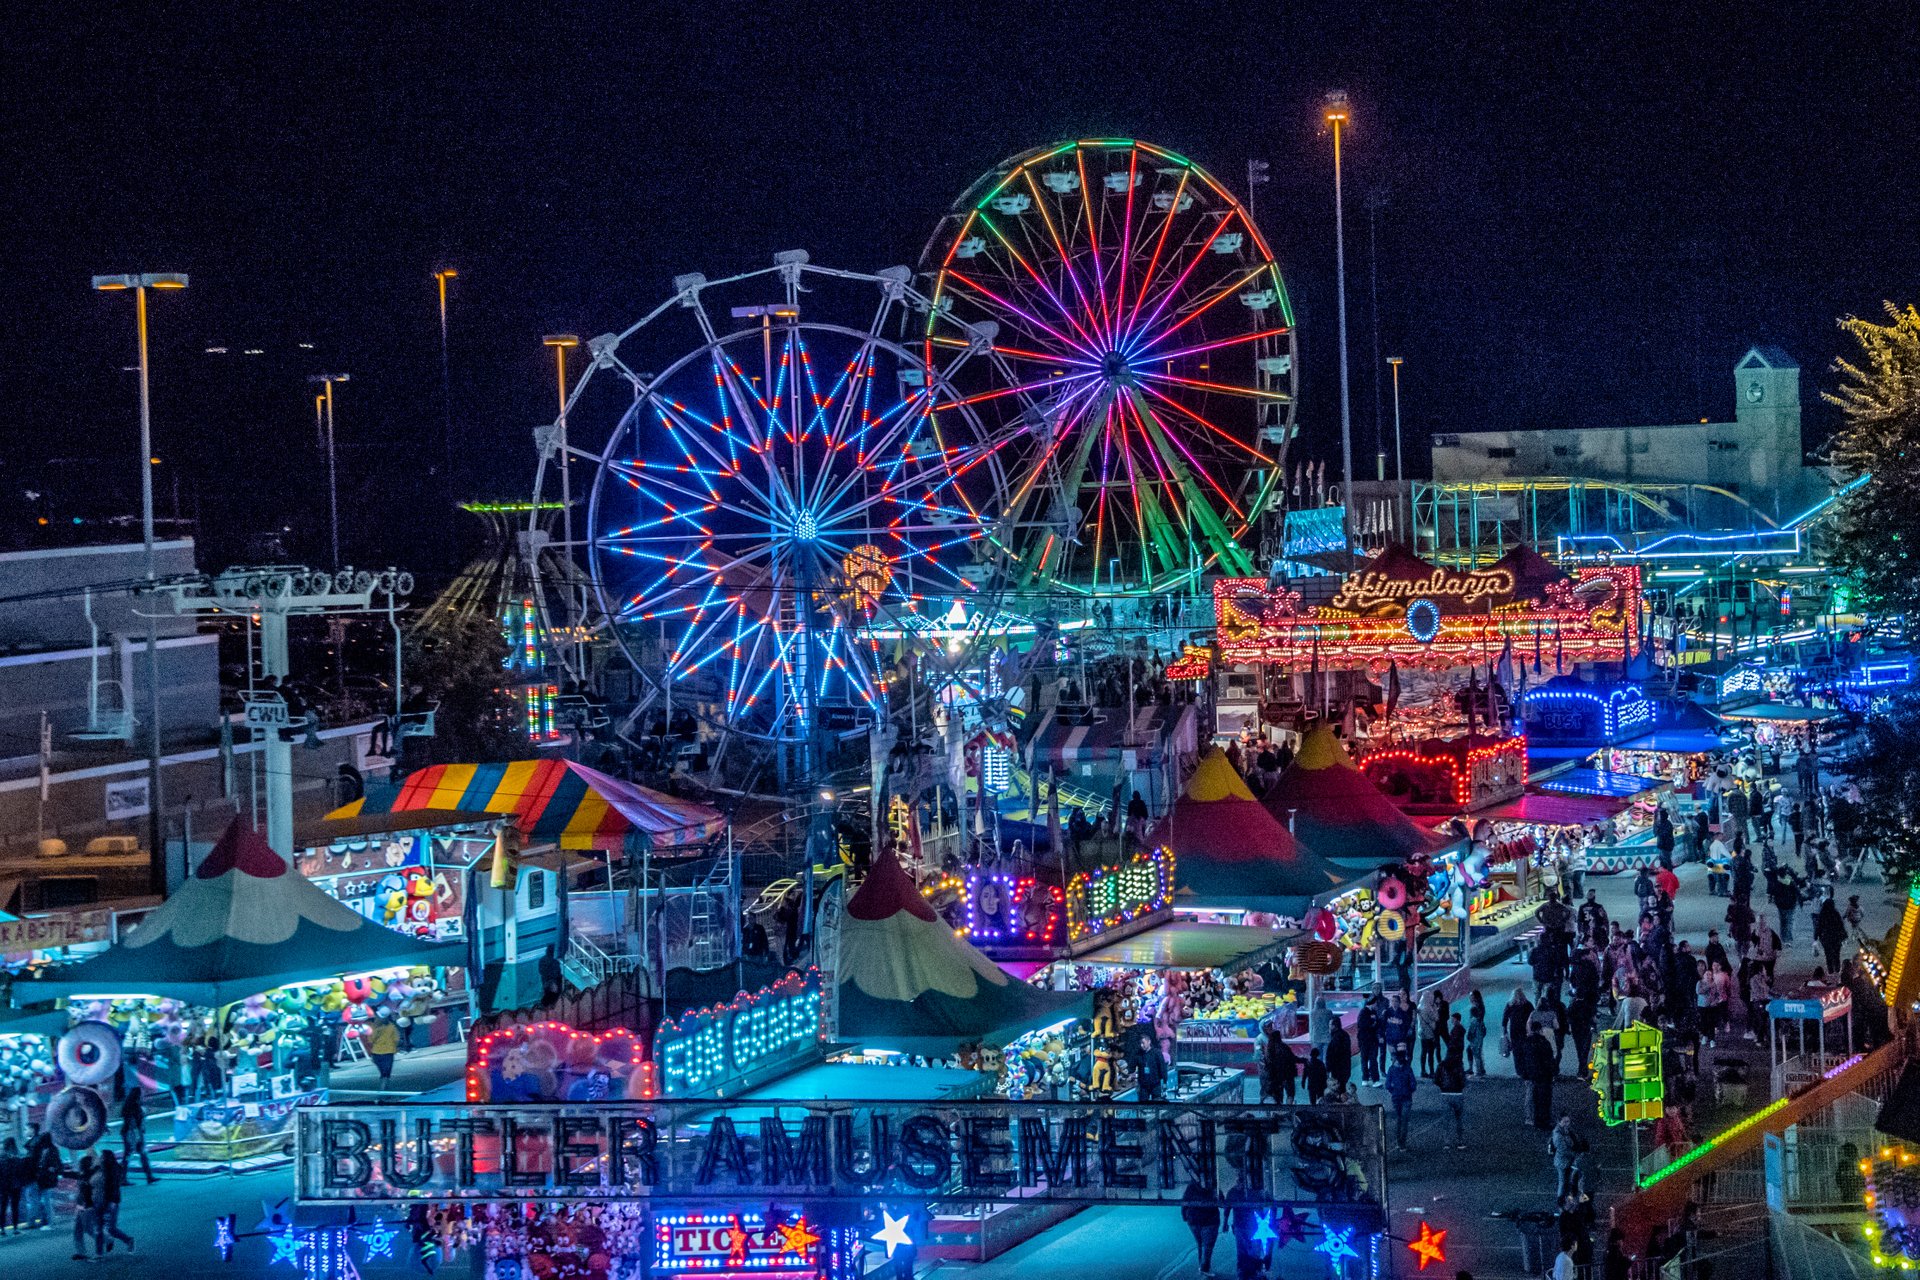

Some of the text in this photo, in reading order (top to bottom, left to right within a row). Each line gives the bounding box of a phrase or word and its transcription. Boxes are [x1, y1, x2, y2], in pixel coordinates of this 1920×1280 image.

[1332, 568, 1515, 608] Himalaya
[248, 706, 285, 722] CWU
[1544, 714, 1583, 729] BUST
[664, 989, 821, 1094] FUN GAMES
[1212, 1024, 1232, 1037] DUCK
[322, 1115, 1346, 1192] BUTLER AMUSEMENTS
[675, 1227, 817, 1252] TICKE
